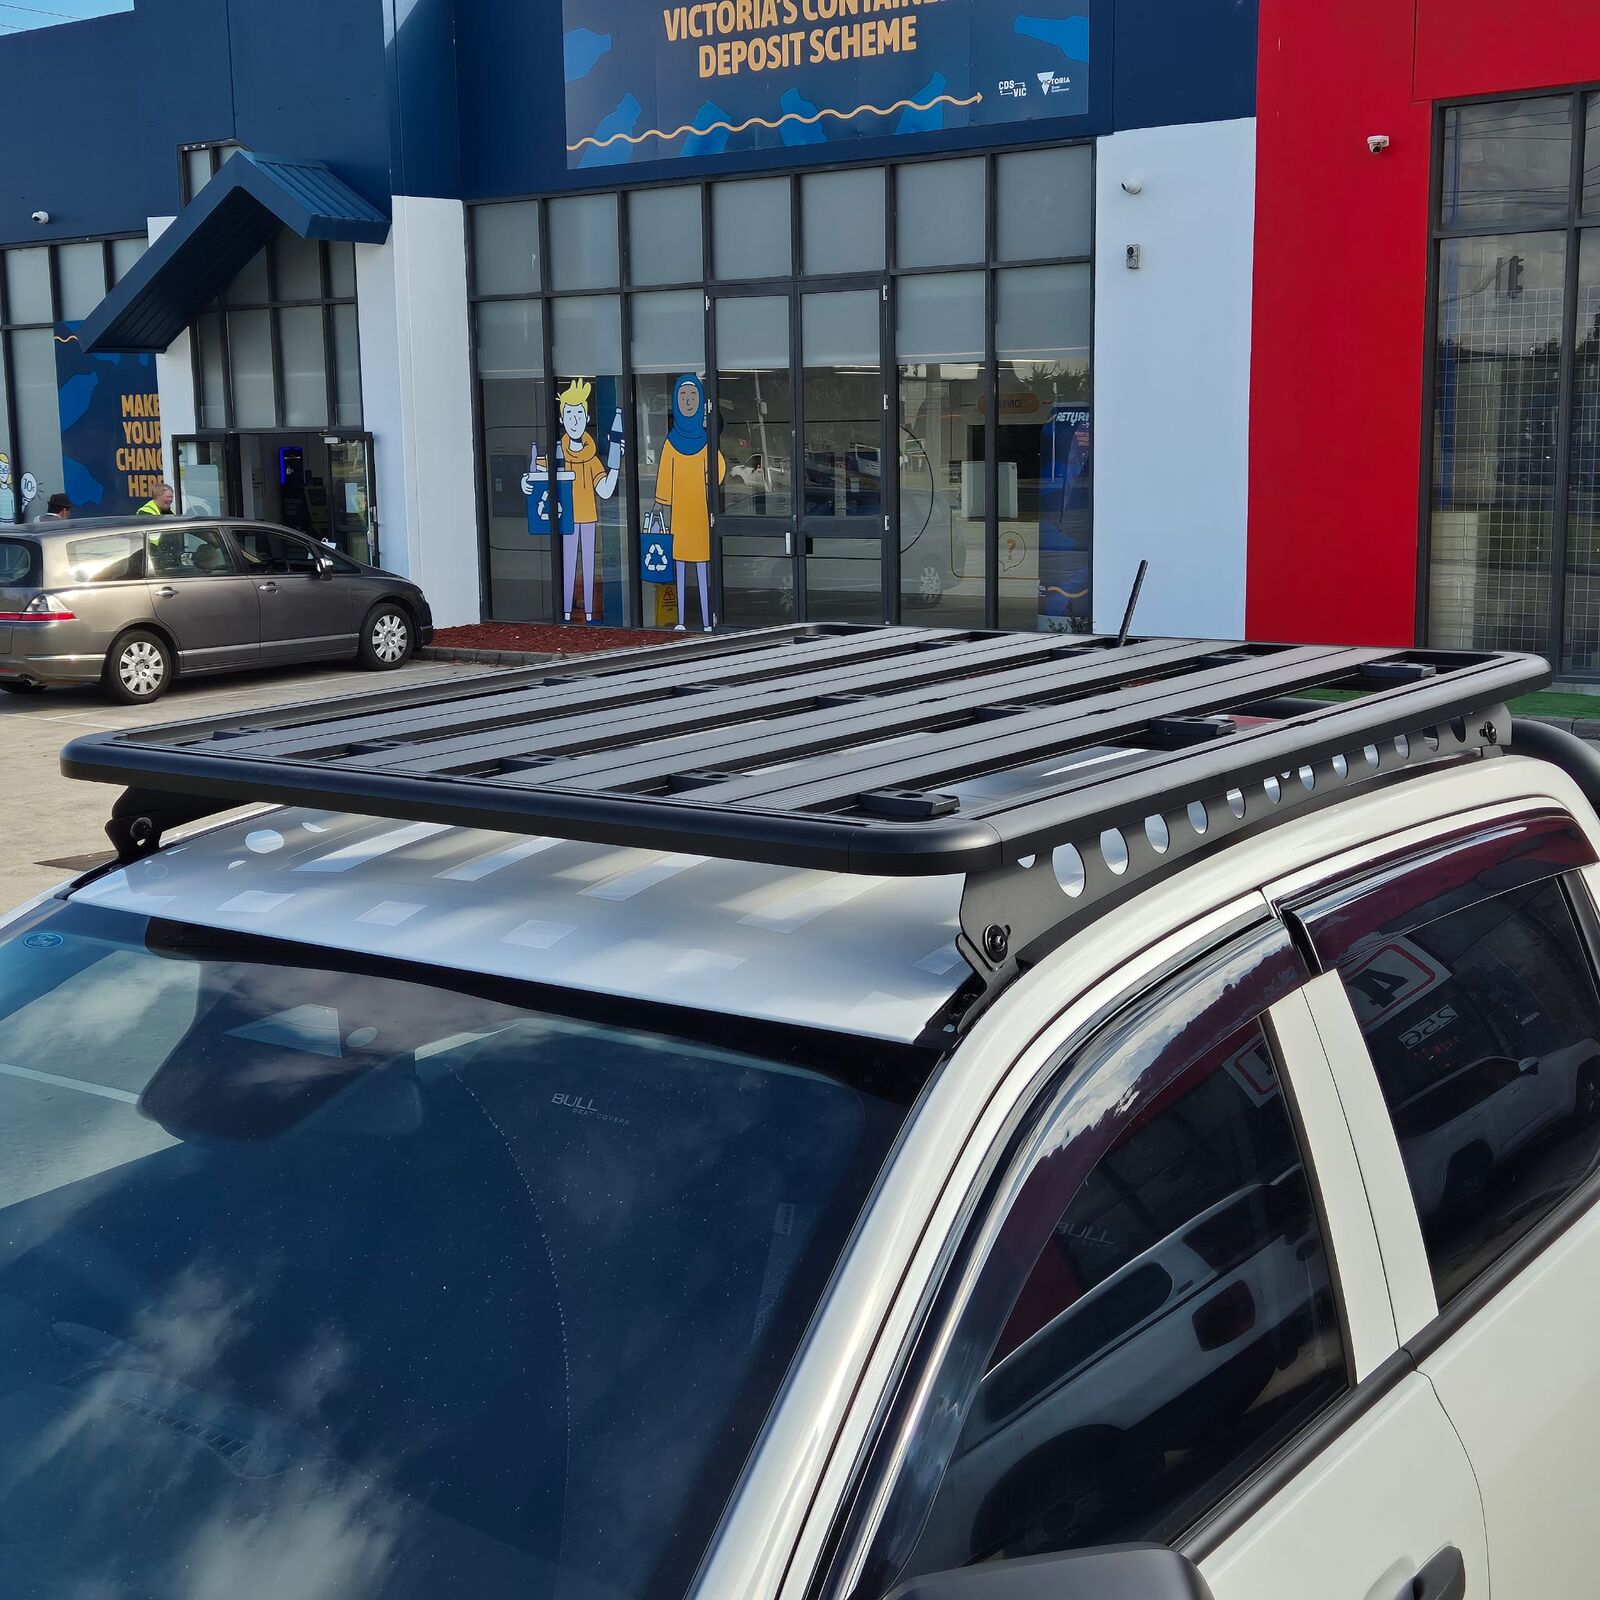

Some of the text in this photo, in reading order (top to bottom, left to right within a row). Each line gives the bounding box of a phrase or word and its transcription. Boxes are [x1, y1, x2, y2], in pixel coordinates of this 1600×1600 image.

[663, 0, 798, 41] VICTORIAS
[699, 15, 917, 78] DEPOSIT SCHEME
[998, 80, 1015, 90] CDS
[1013, 87, 1027, 97] VIC
[127, 474, 164, 497] HER
[551, 1093, 597, 1111] BULL
